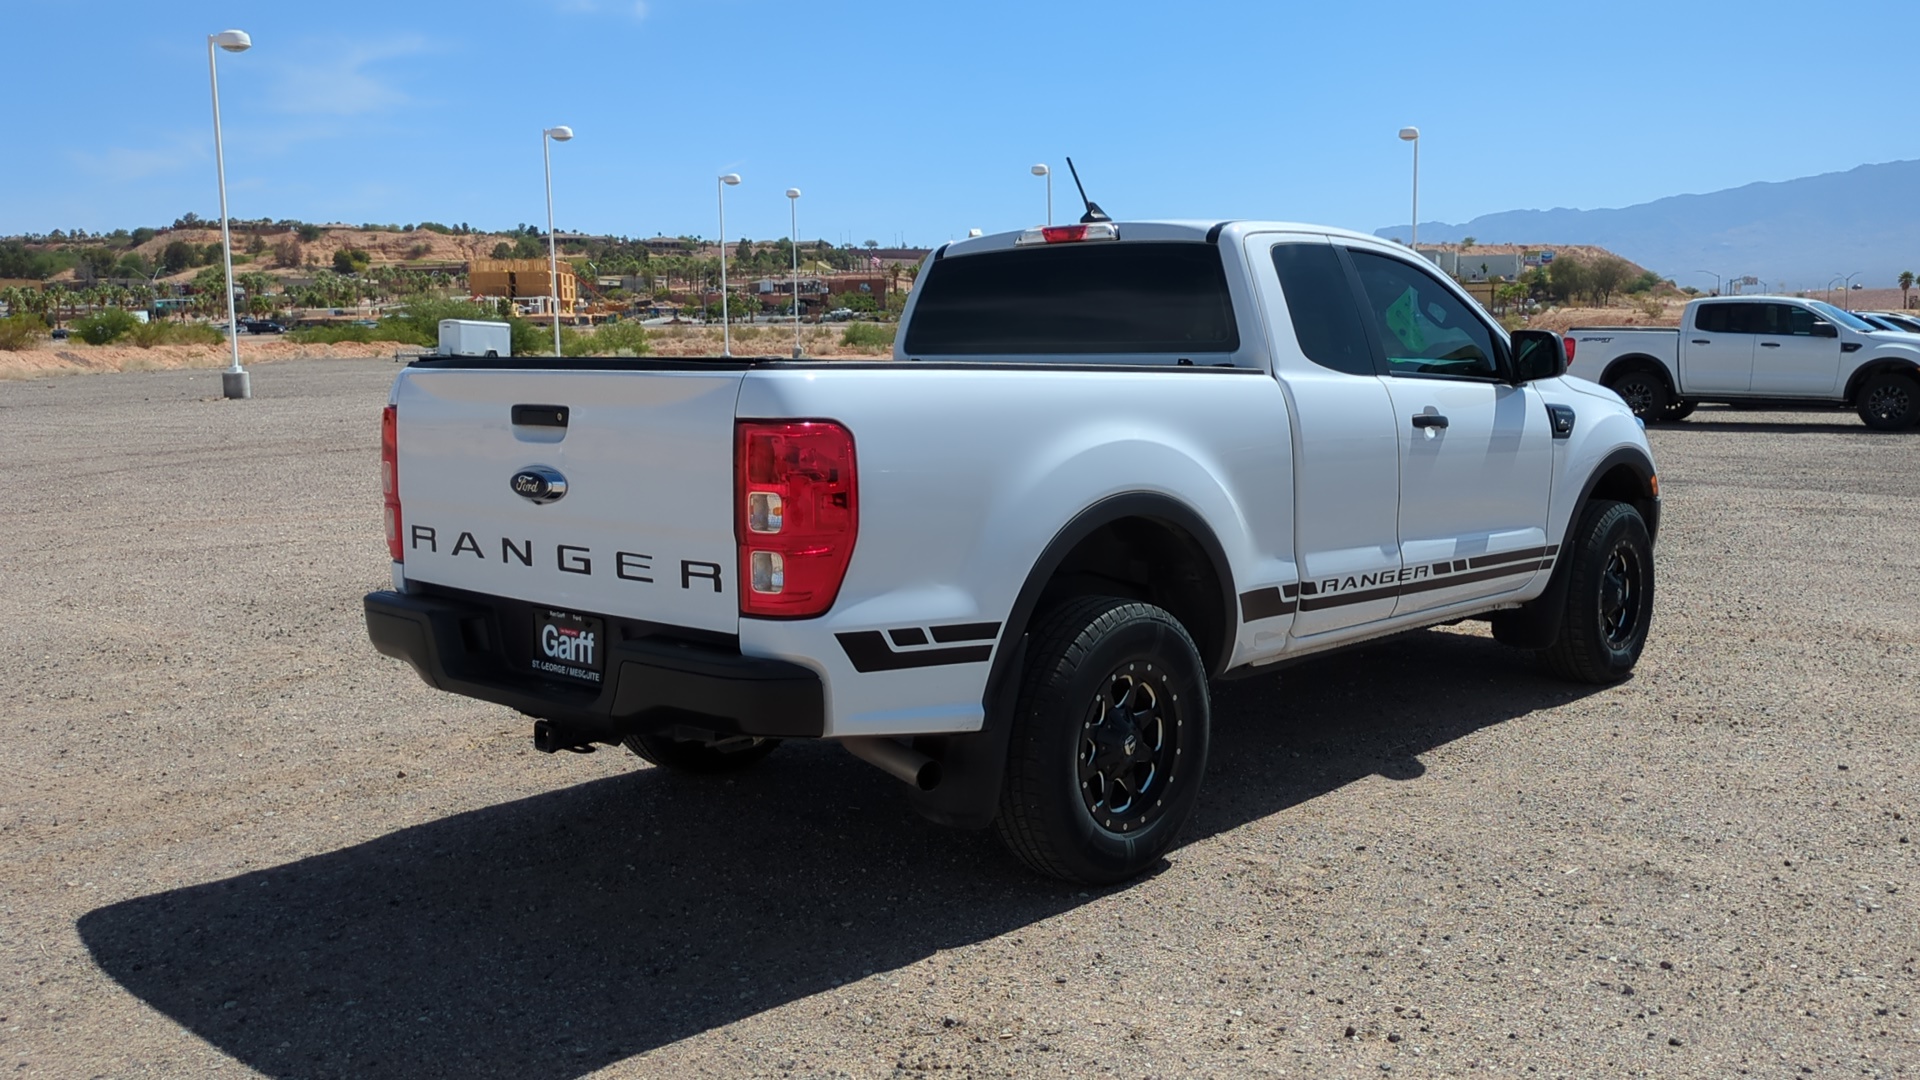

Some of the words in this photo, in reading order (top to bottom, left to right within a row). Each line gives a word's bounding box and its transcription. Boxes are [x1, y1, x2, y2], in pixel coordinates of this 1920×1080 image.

[516, 475, 539, 492] Ford
[411, 524, 722, 593] RANGER
[1321, 565, 1429, 593] RANGER
[542, 624, 594, 664] Garff
[541, 662, 566, 674] GEORGE
[569, 667, 600, 682] MESQUITE
